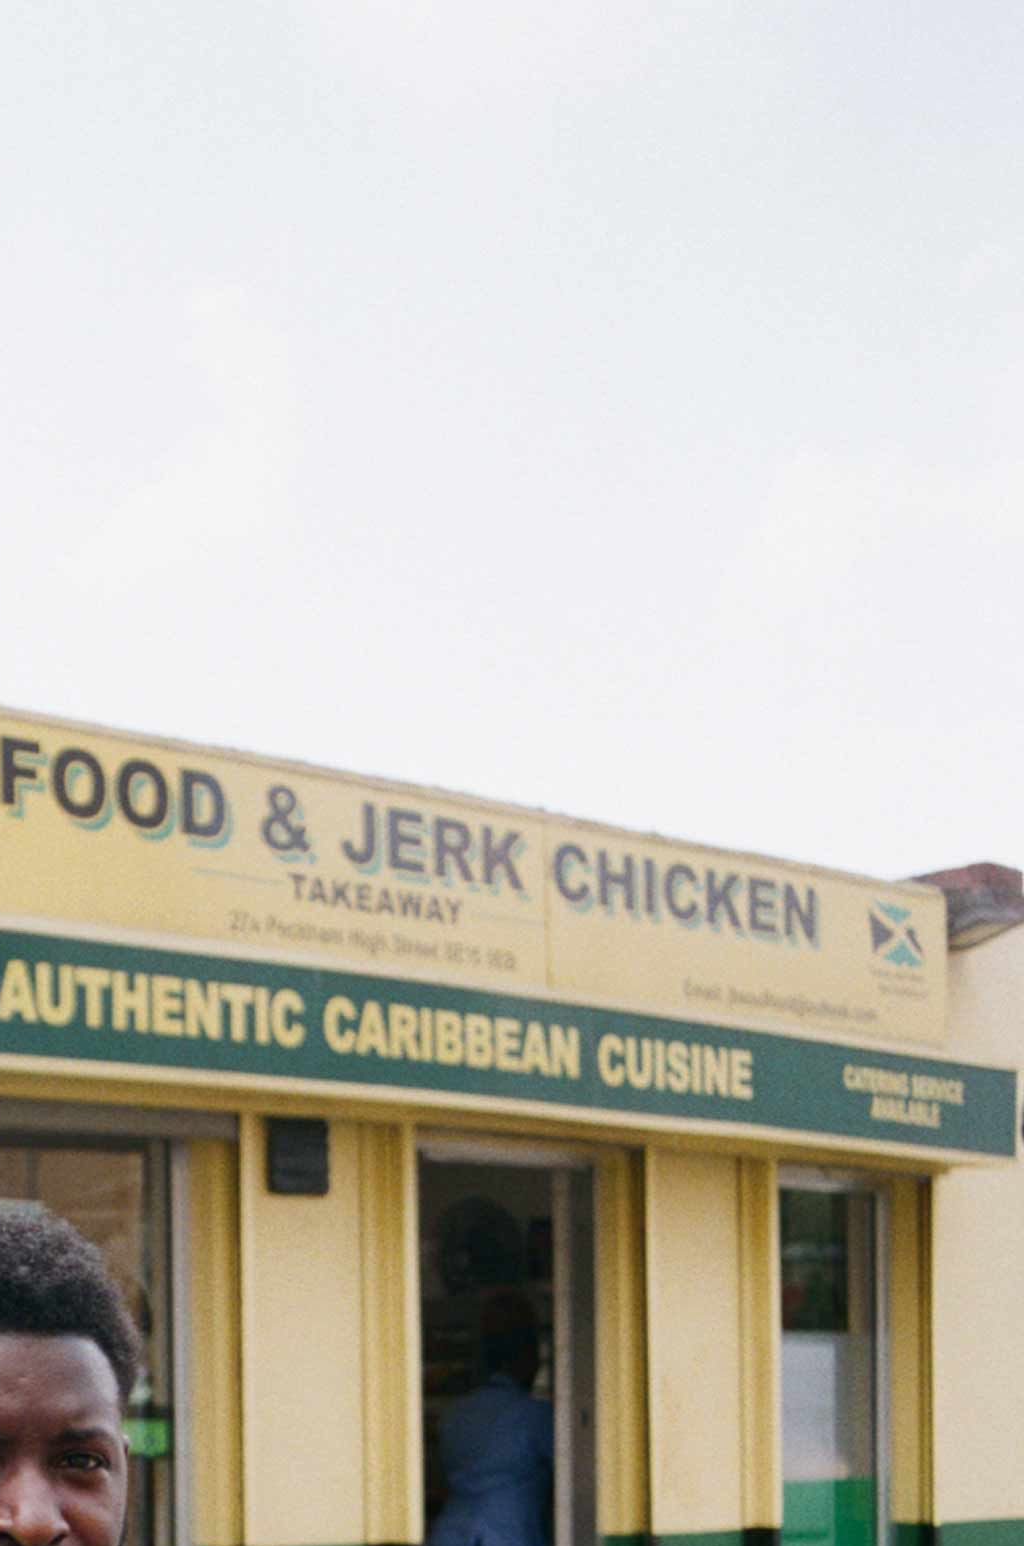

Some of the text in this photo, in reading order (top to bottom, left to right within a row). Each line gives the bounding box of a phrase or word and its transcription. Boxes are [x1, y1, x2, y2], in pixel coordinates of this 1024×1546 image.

[260, 784, 317, 865] &
[342, 802, 532, 901] JERK
[552, 842, 821, 950] CHICKEN
[287, 872, 464, 926] TAKEAWAY
[322, 995, 581, 1080] CARIBBEAN
[596, 1032, 755, 1101] CUISINE
